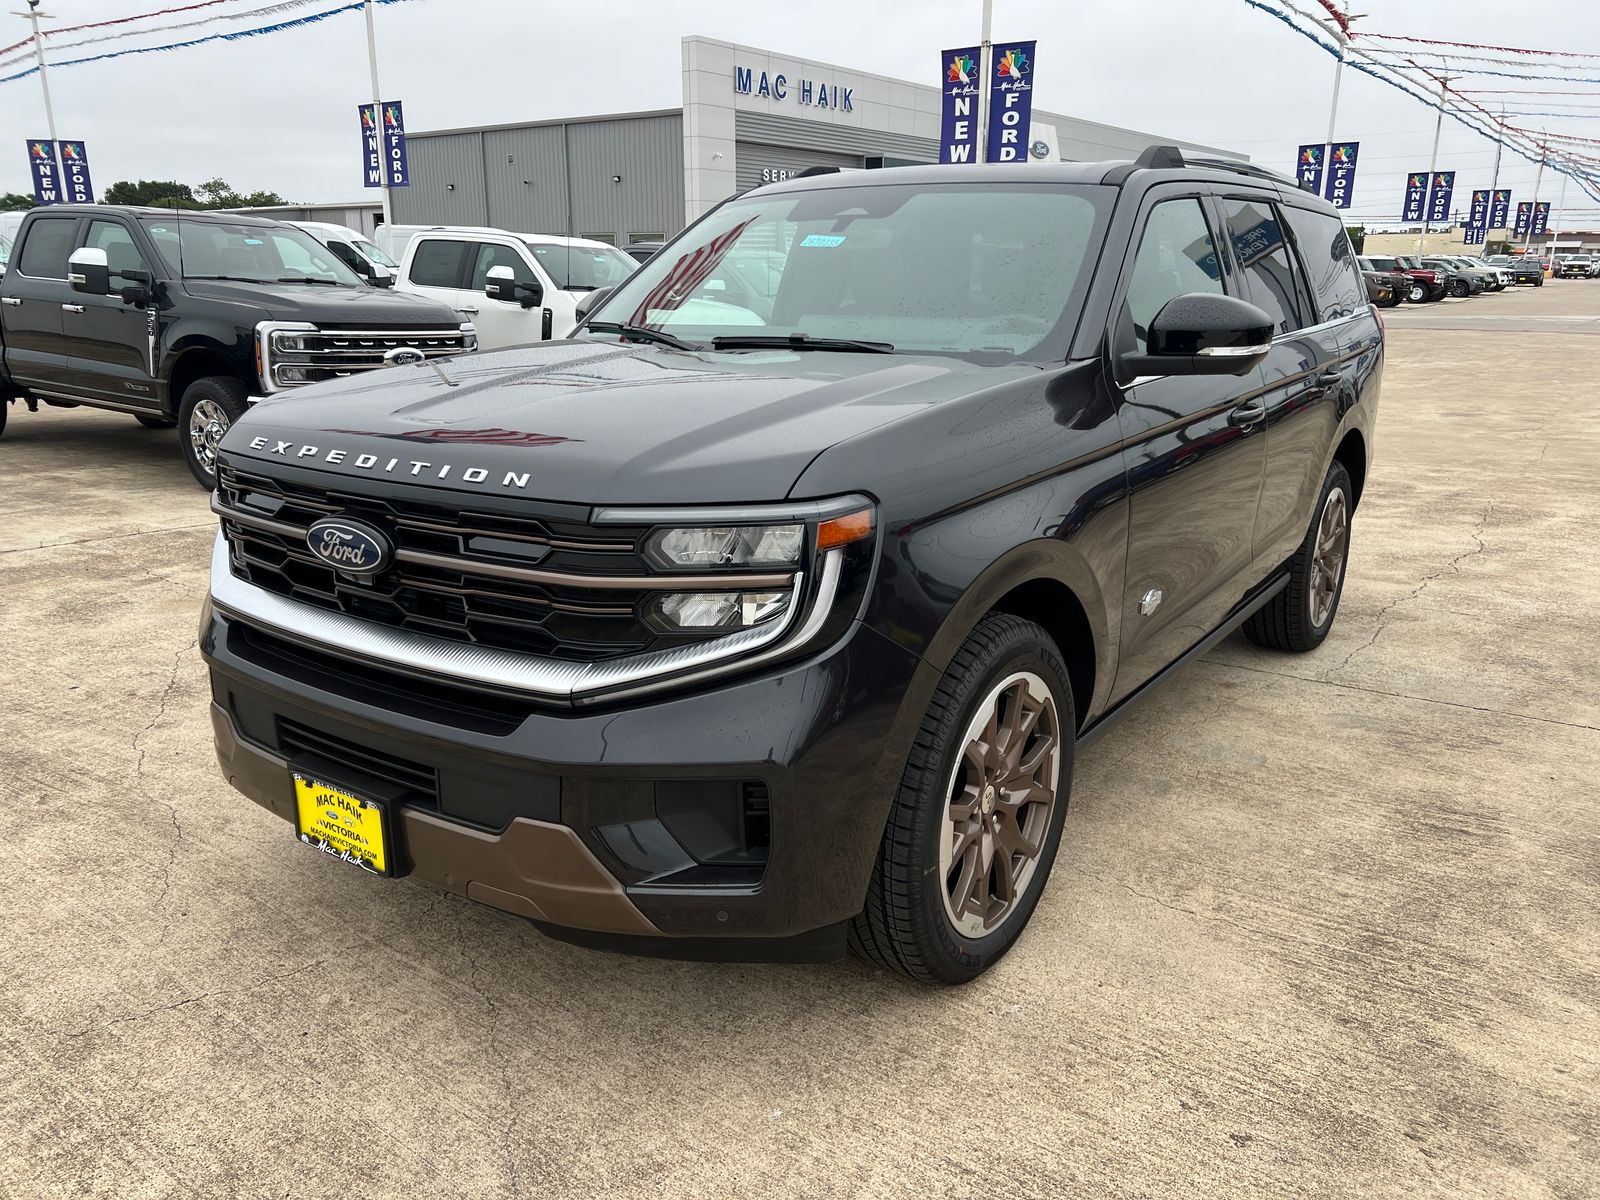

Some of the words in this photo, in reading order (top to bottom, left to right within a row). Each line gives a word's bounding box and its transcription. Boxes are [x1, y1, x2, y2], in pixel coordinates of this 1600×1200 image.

[735, 66, 787, 100] MAC
[800, 79, 854, 112] HAIK
[950, 97, 971, 163] NEW
[1000, 93, 1020, 161] FORD
[368, 138, 380, 183] NEW
[391, 136, 403, 183] FORD
[39, 165, 56, 201] NEW
[72, 166, 86, 201] FORD
[1332, 169, 1347, 207] FORD
[1407, 192, 1420, 220] NEW
[1433, 191, 1446, 220] FORD
[1472, 205, 1483, 228] NEW
[1493, 205, 1504, 228] FORD
[1517, 214, 1526, 234] NEW
[1534, 215, 1544, 234] FORD
[249, 436, 531, 488] EXPEDITION
[320, 529, 365, 565] Ford
[316, 794, 336, 807] MAC
[337, 796, 363, 823] HAIK
[322, 820, 363, 843] VICTORIA
[317, 839, 339, 857] Mac
[340, 850, 368, 868] Haik
